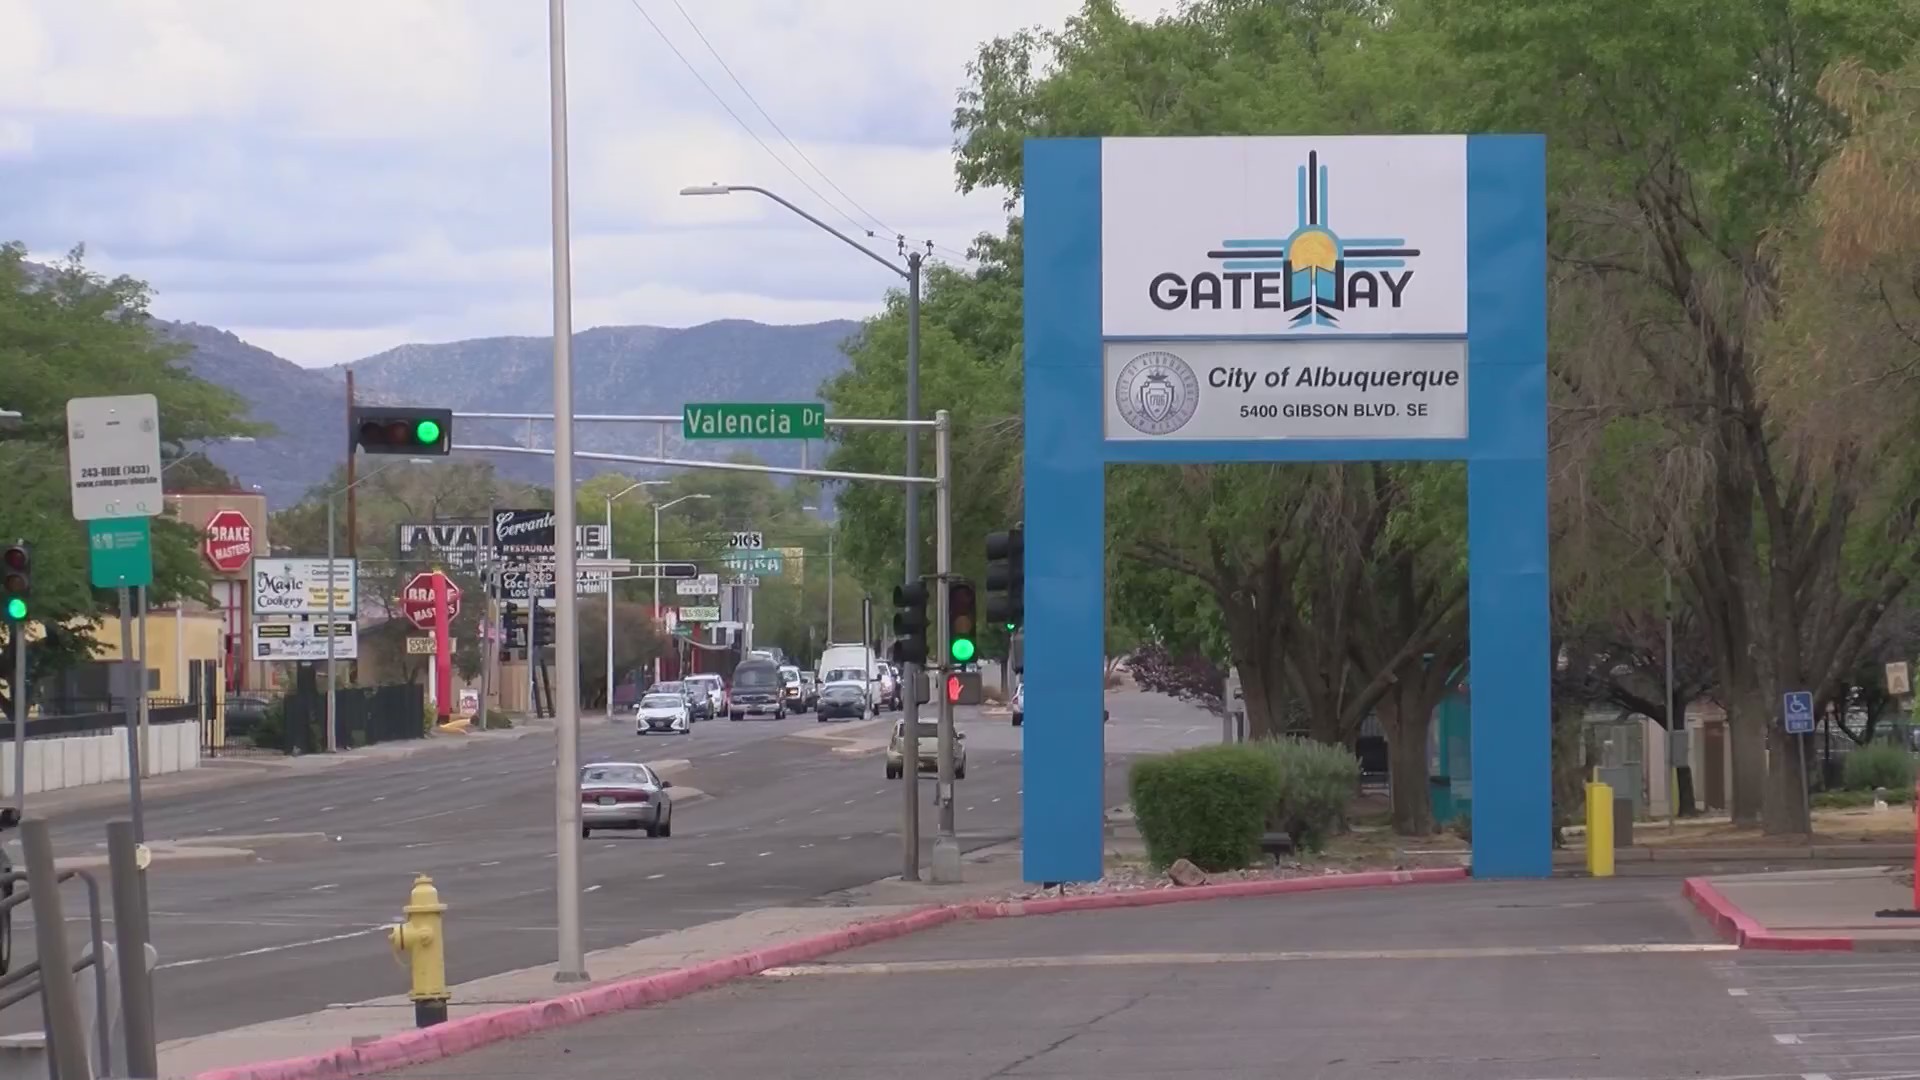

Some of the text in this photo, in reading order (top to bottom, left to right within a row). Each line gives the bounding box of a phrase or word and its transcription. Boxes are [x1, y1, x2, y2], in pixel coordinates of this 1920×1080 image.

[1149, 260, 1414, 312] GATEWAY
[1208, 367, 1460, 393] City of Albuquerque
[1240, 403, 1428, 418] 5400 GIBSON BLVD. SE
[687, 408, 822, 434] Valencia Dr
[211, 527, 250, 541] BRAKE
[496, 512, 557, 541] Cervante
[258, 576, 303, 594] Magic
[258, 595, 303, 609] Cookery
[408, 588, 457, 602] BRAE
